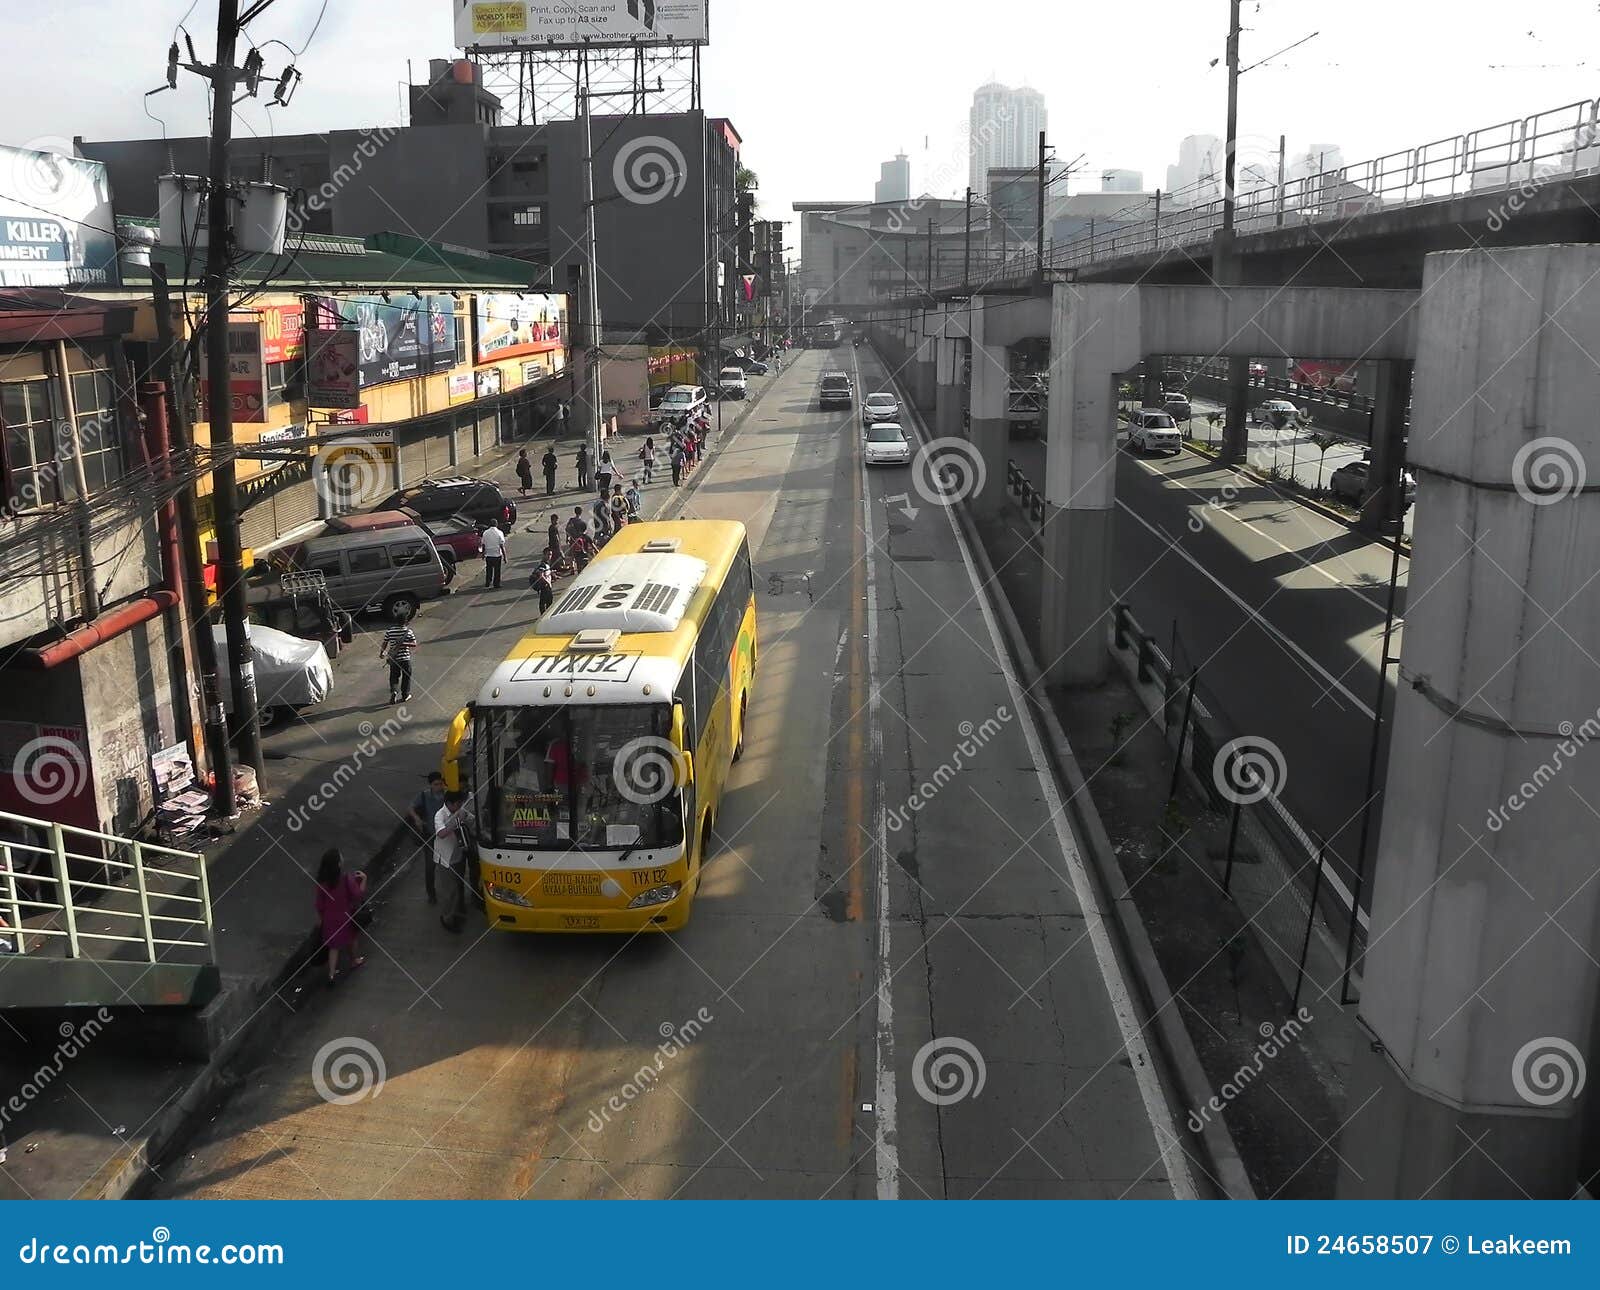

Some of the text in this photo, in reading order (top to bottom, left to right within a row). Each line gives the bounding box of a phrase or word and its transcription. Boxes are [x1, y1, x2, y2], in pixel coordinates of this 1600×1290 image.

[601, 4, 616, 12] and
[539, 16, 553, 24] Fax
[567, 16, 576, 24] to
[590, 15, 608, 23] size
[6, 220, 63, 242] KILLER
[512, 808, 551, 821] AYALA
[492, 871, 521, 884] 1103
[632, 869, 667, 885] TYX 132
